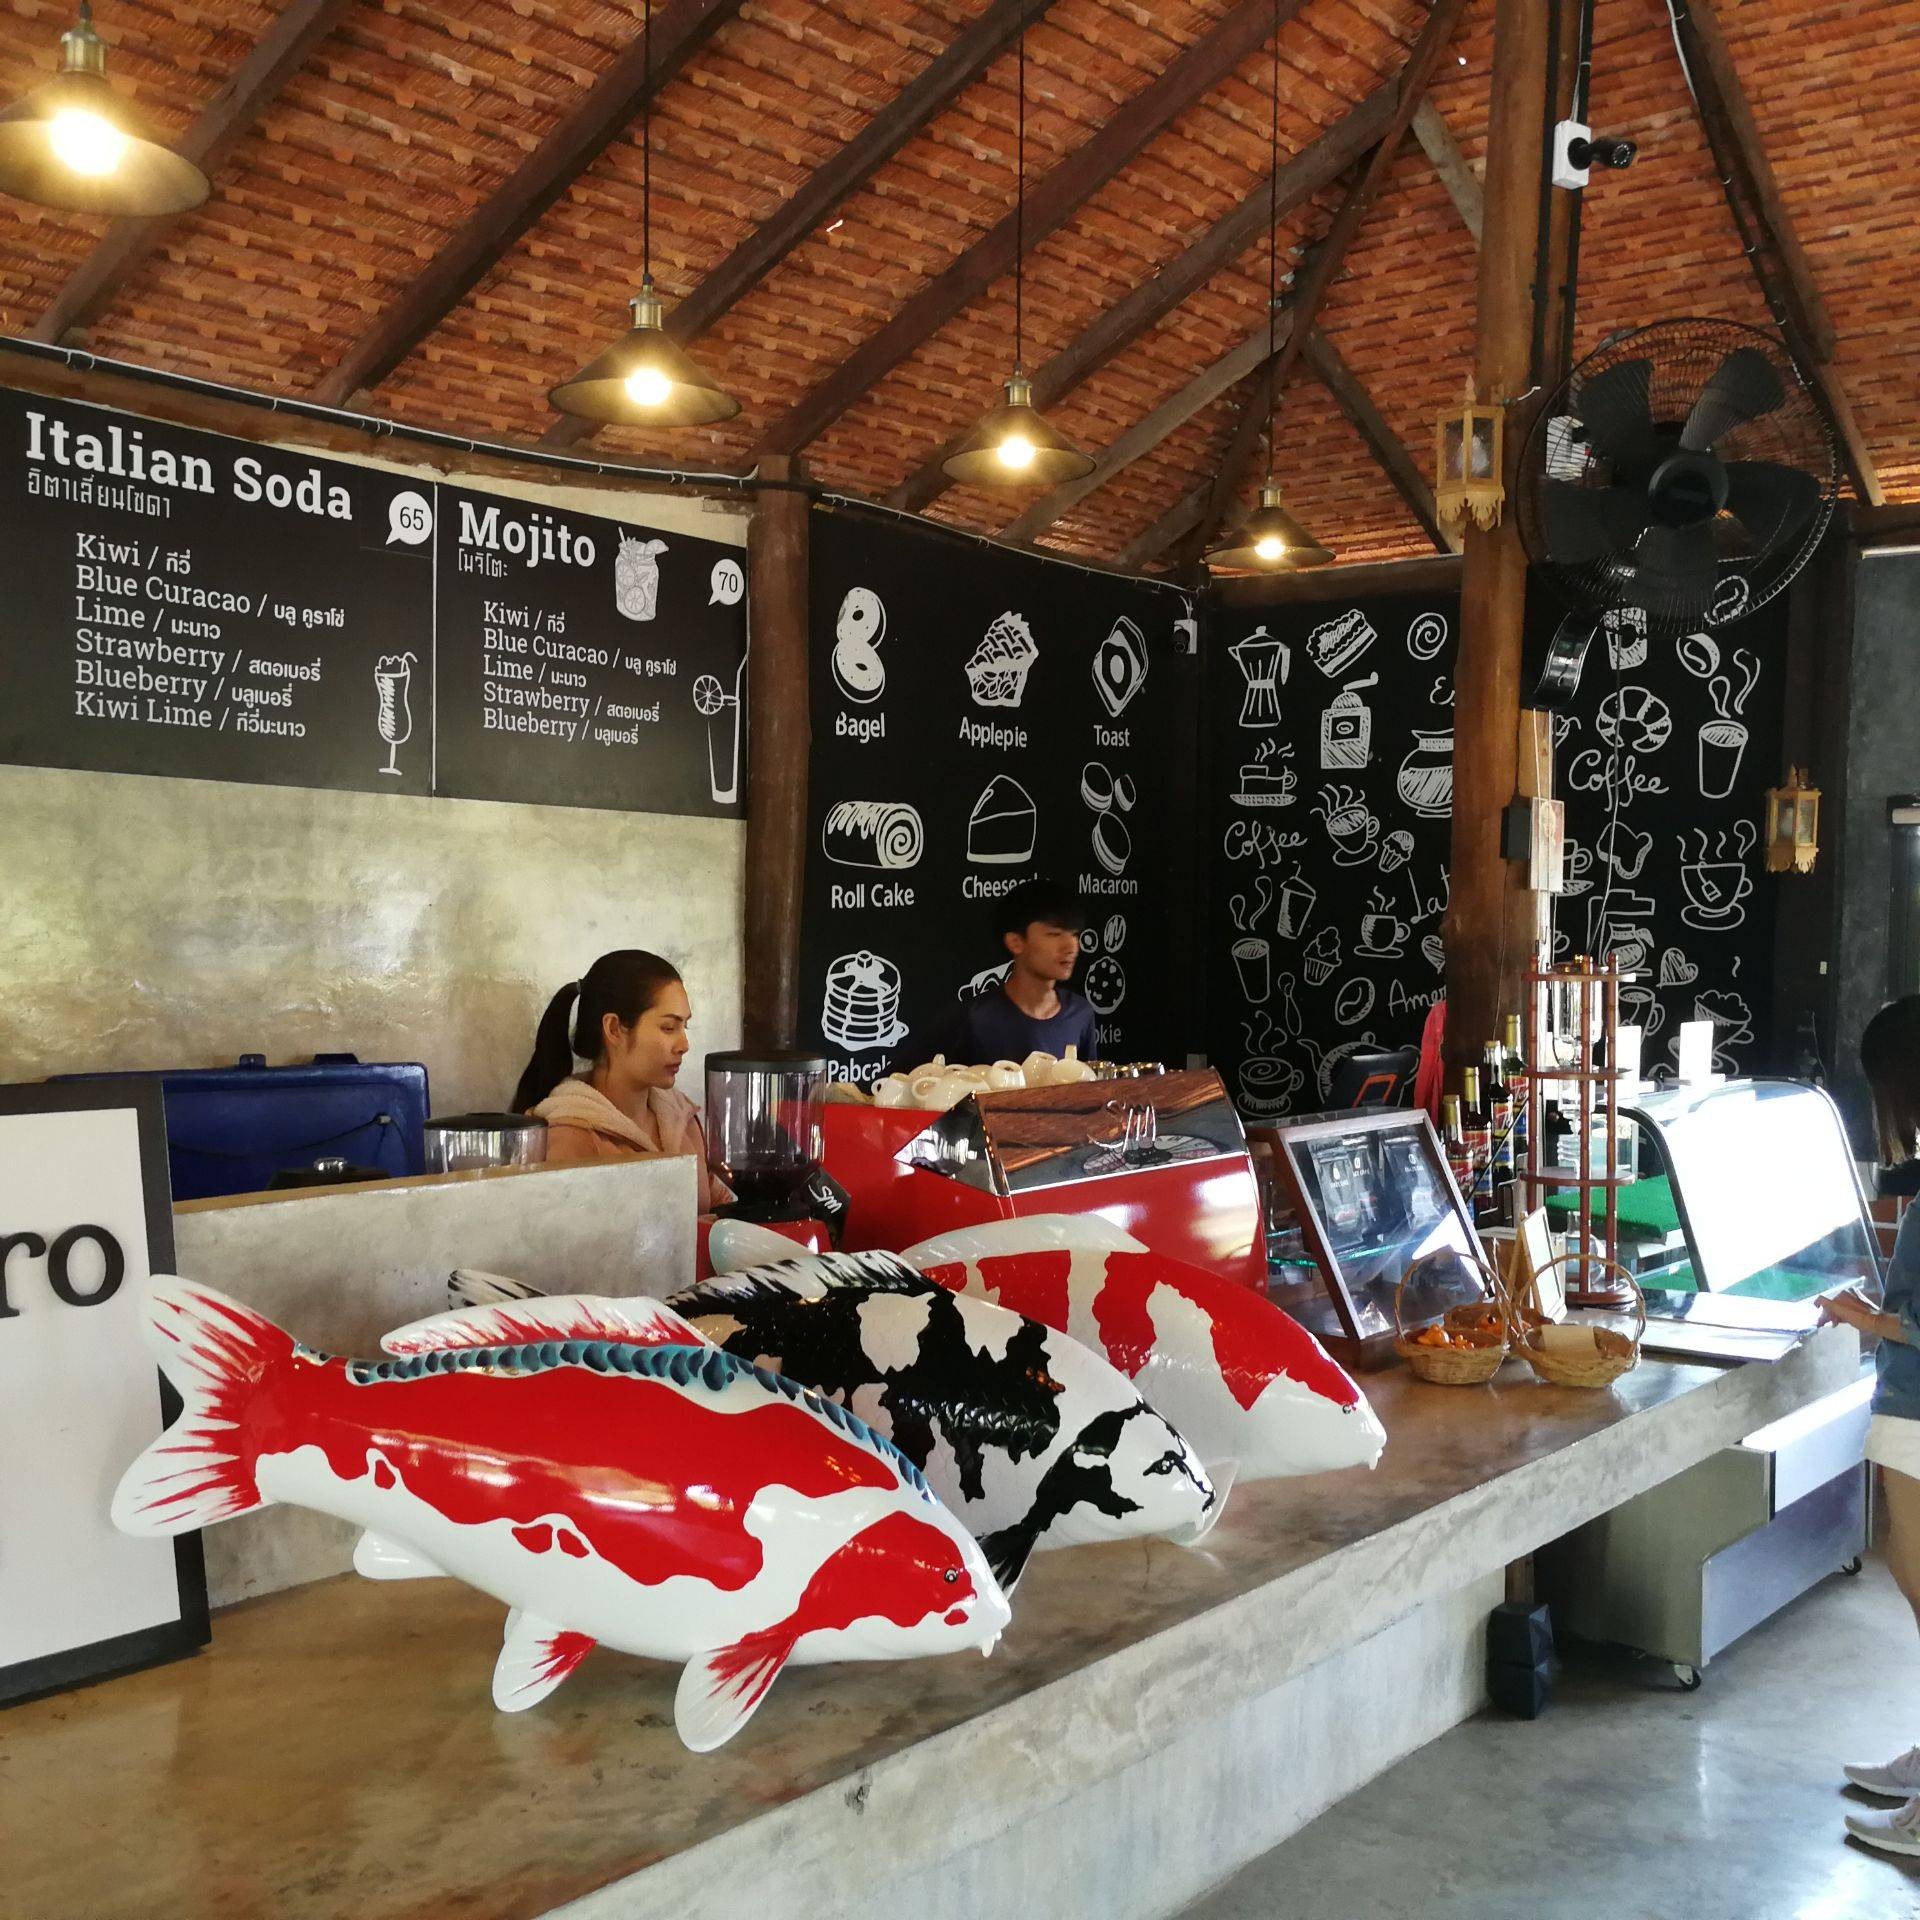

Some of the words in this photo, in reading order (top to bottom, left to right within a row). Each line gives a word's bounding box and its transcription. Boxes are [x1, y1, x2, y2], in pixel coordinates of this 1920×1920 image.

[26, 411, 215, 494] Italian
[233, 456, 353, 520] Soda
[399, 506, 425, 531] 65
[459, 501, 596, 568] Mojito
[76, 532, 140, 567] Kiwi
[148, 546, 159, 570] /
[166, 549, 191, 575] กีวี่
[76, 564, 138, 596] Blue
[146, 577, 250, 614] Curacao
[257, 594, 268, 618] /
[274, 604, 296, 626] บลู
[719, 571, 738, 593] 70
[76, 596, 145, 628] Lime
[153, 608, 164, 632] /
[171, 617, 221, 639] มะนาว
[484, 601, 530, 628] Kiwi
[534, 609, 543, 631] /
[547, 611, 566, 633] กีวี่
[76, 629, 225, 675] Strawberry
[231, 649, 242, 673] /
[249, 657, 321, 682] สตอเบอรี่
[483, 627, 528, 654] Blue
[533, 635, 608, 665] Curacao
[612, 648, 621, 668] /
[625, 656, 642, 676] บลู
[483, 654, 533, 681] Lime
[538, 662, 546, 683] /
[551, 670, 586, 688] มะนาว
[76, 659, 208, 703] Blueberry
[214, 677, 225, 701] /
[231, 682, 293, 709] บลูเบอรี่
[484, 681, 591, 719] Strawberry
[594, 695, 602, 716] /
[606, 701, 660, 722] สตอเบอรี่
[76, 691, 139, 721] Kiwi
[147, 699, 212, 728] Lime
[219, 707, 230, 731] /
[237, 708, 306, 738] กีวี่มะนาว
[483, 707, 577, 742] Blueberry
[581, 720, 589, 740] /
[594, 723, 639, 747] บลูเบอรี่
[835, 711, 885, 743] Bagel
[959, 717, 1028, 751] Applepie
[1094, 725, 1130, 747] Toast
[1569, 749, 1669, 812] Coffee
[1224, 820, 1308, 869] Coffee
[831, 883, 865, 909] Roll
[871, 882, 915, 907] Cake
[1078, 873, 1138, 895] Macaron
[1408, 864, 1450, 924] Lat
[0, 1224, 125, 1318] ro
